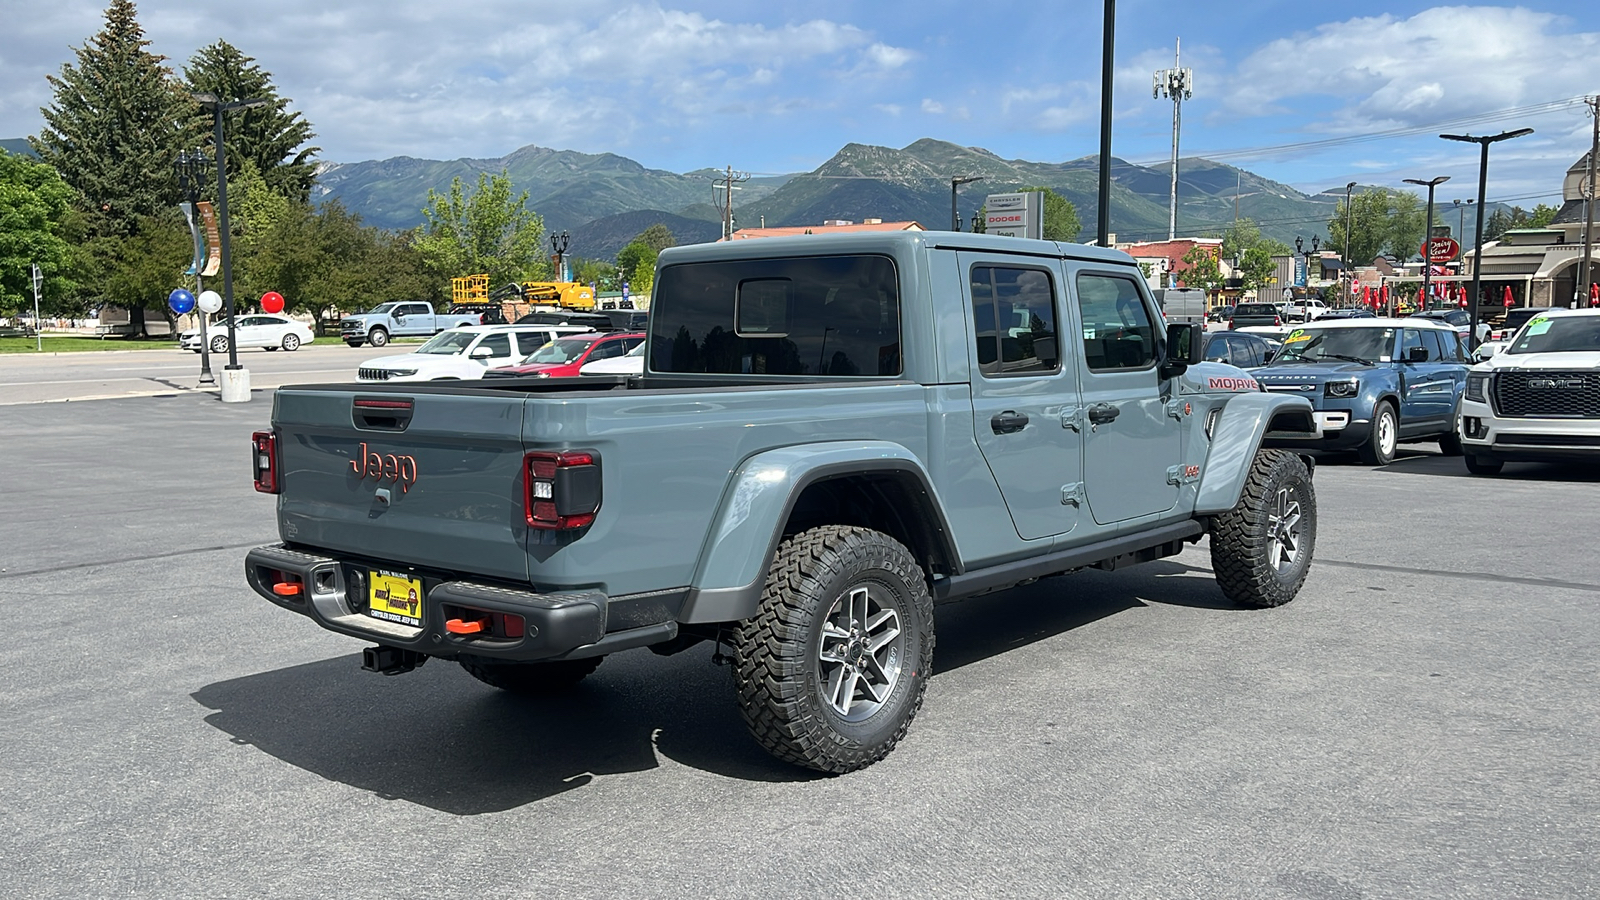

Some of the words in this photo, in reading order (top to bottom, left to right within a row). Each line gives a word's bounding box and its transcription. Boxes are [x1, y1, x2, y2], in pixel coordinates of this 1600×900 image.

[1430, 240, 1452, 251] Dairy
[1430, 247, 1447, 256] Keen
[1208, 377, 1258, 391] MOJAVE
[1528, 379, 1582, 390] GMC
[349, 442, 417, 493] Jeep
